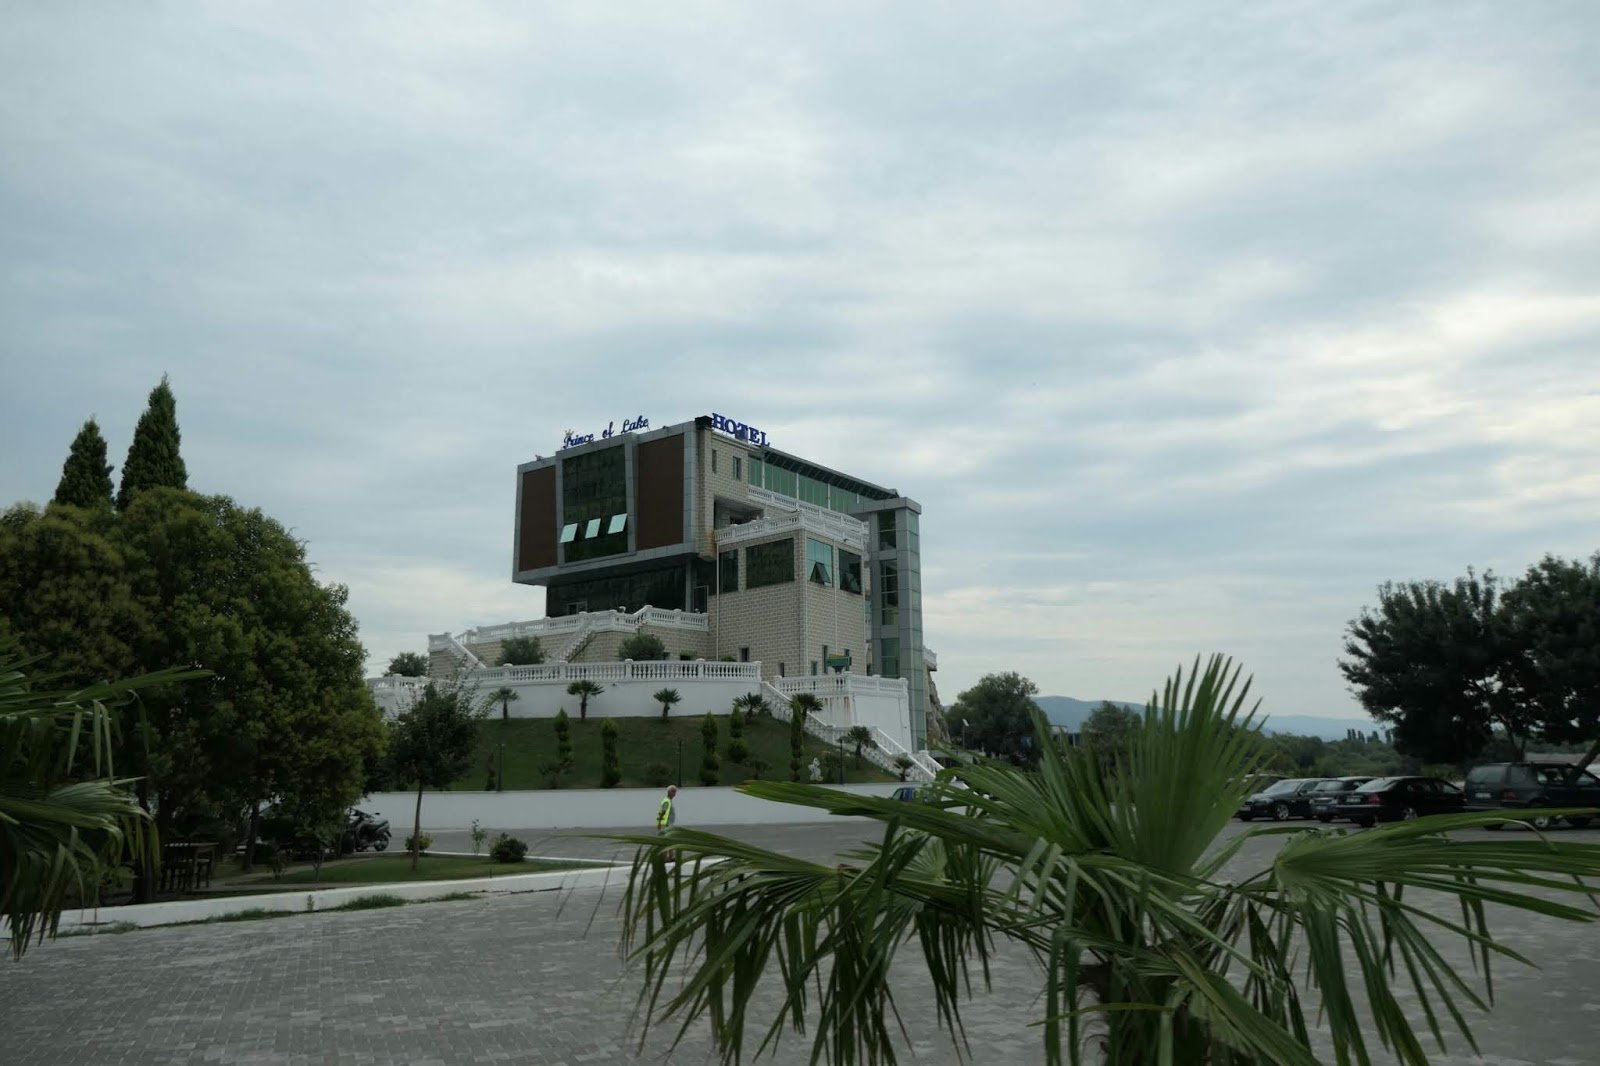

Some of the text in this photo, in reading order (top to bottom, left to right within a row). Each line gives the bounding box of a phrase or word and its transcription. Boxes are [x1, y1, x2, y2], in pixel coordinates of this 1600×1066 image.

[563, 415, 649, 449] Prince of Lake
[711, 413, 771, 447] HOTEL
